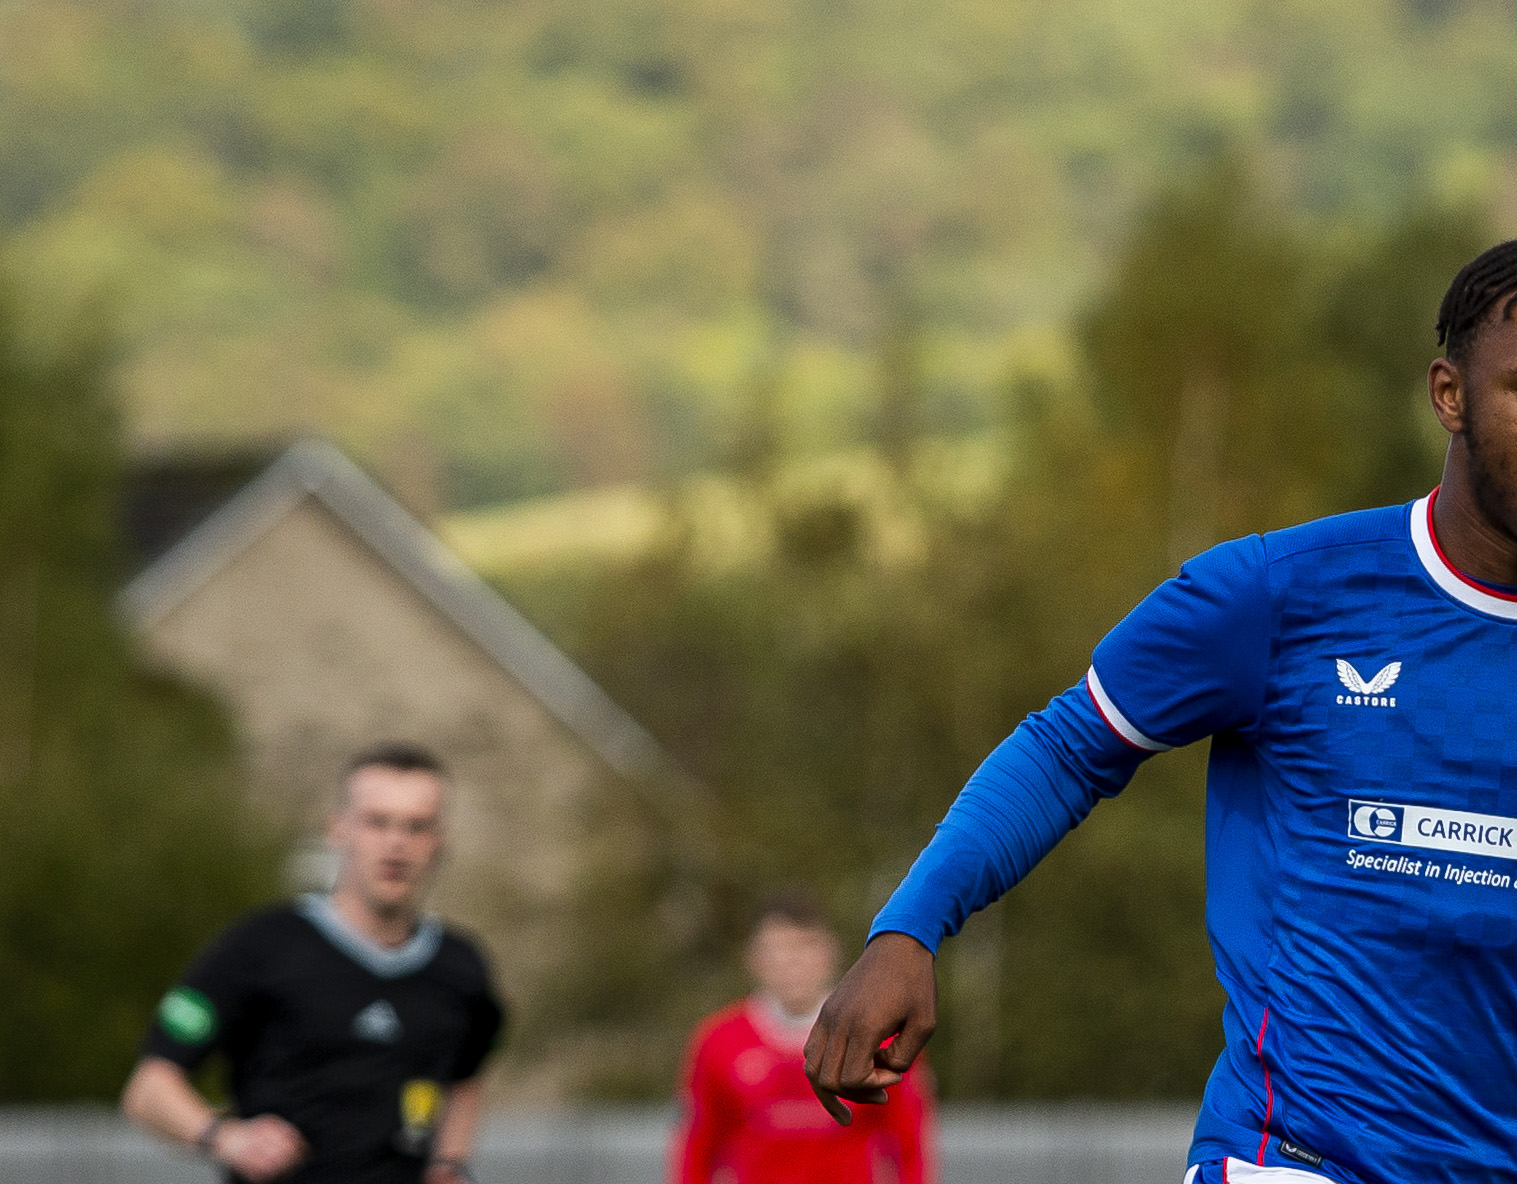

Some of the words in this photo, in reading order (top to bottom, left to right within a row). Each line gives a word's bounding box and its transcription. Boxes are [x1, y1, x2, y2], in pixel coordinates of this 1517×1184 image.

[1335, 694, 1397, 708] CASTORE
[1417, 818, 1514, 848] CARRICK
[1346, 849, 1422, 876] Specialist
[1425, 861, 1441, 878] in
[1444, 864, 1511, 888] Injection
